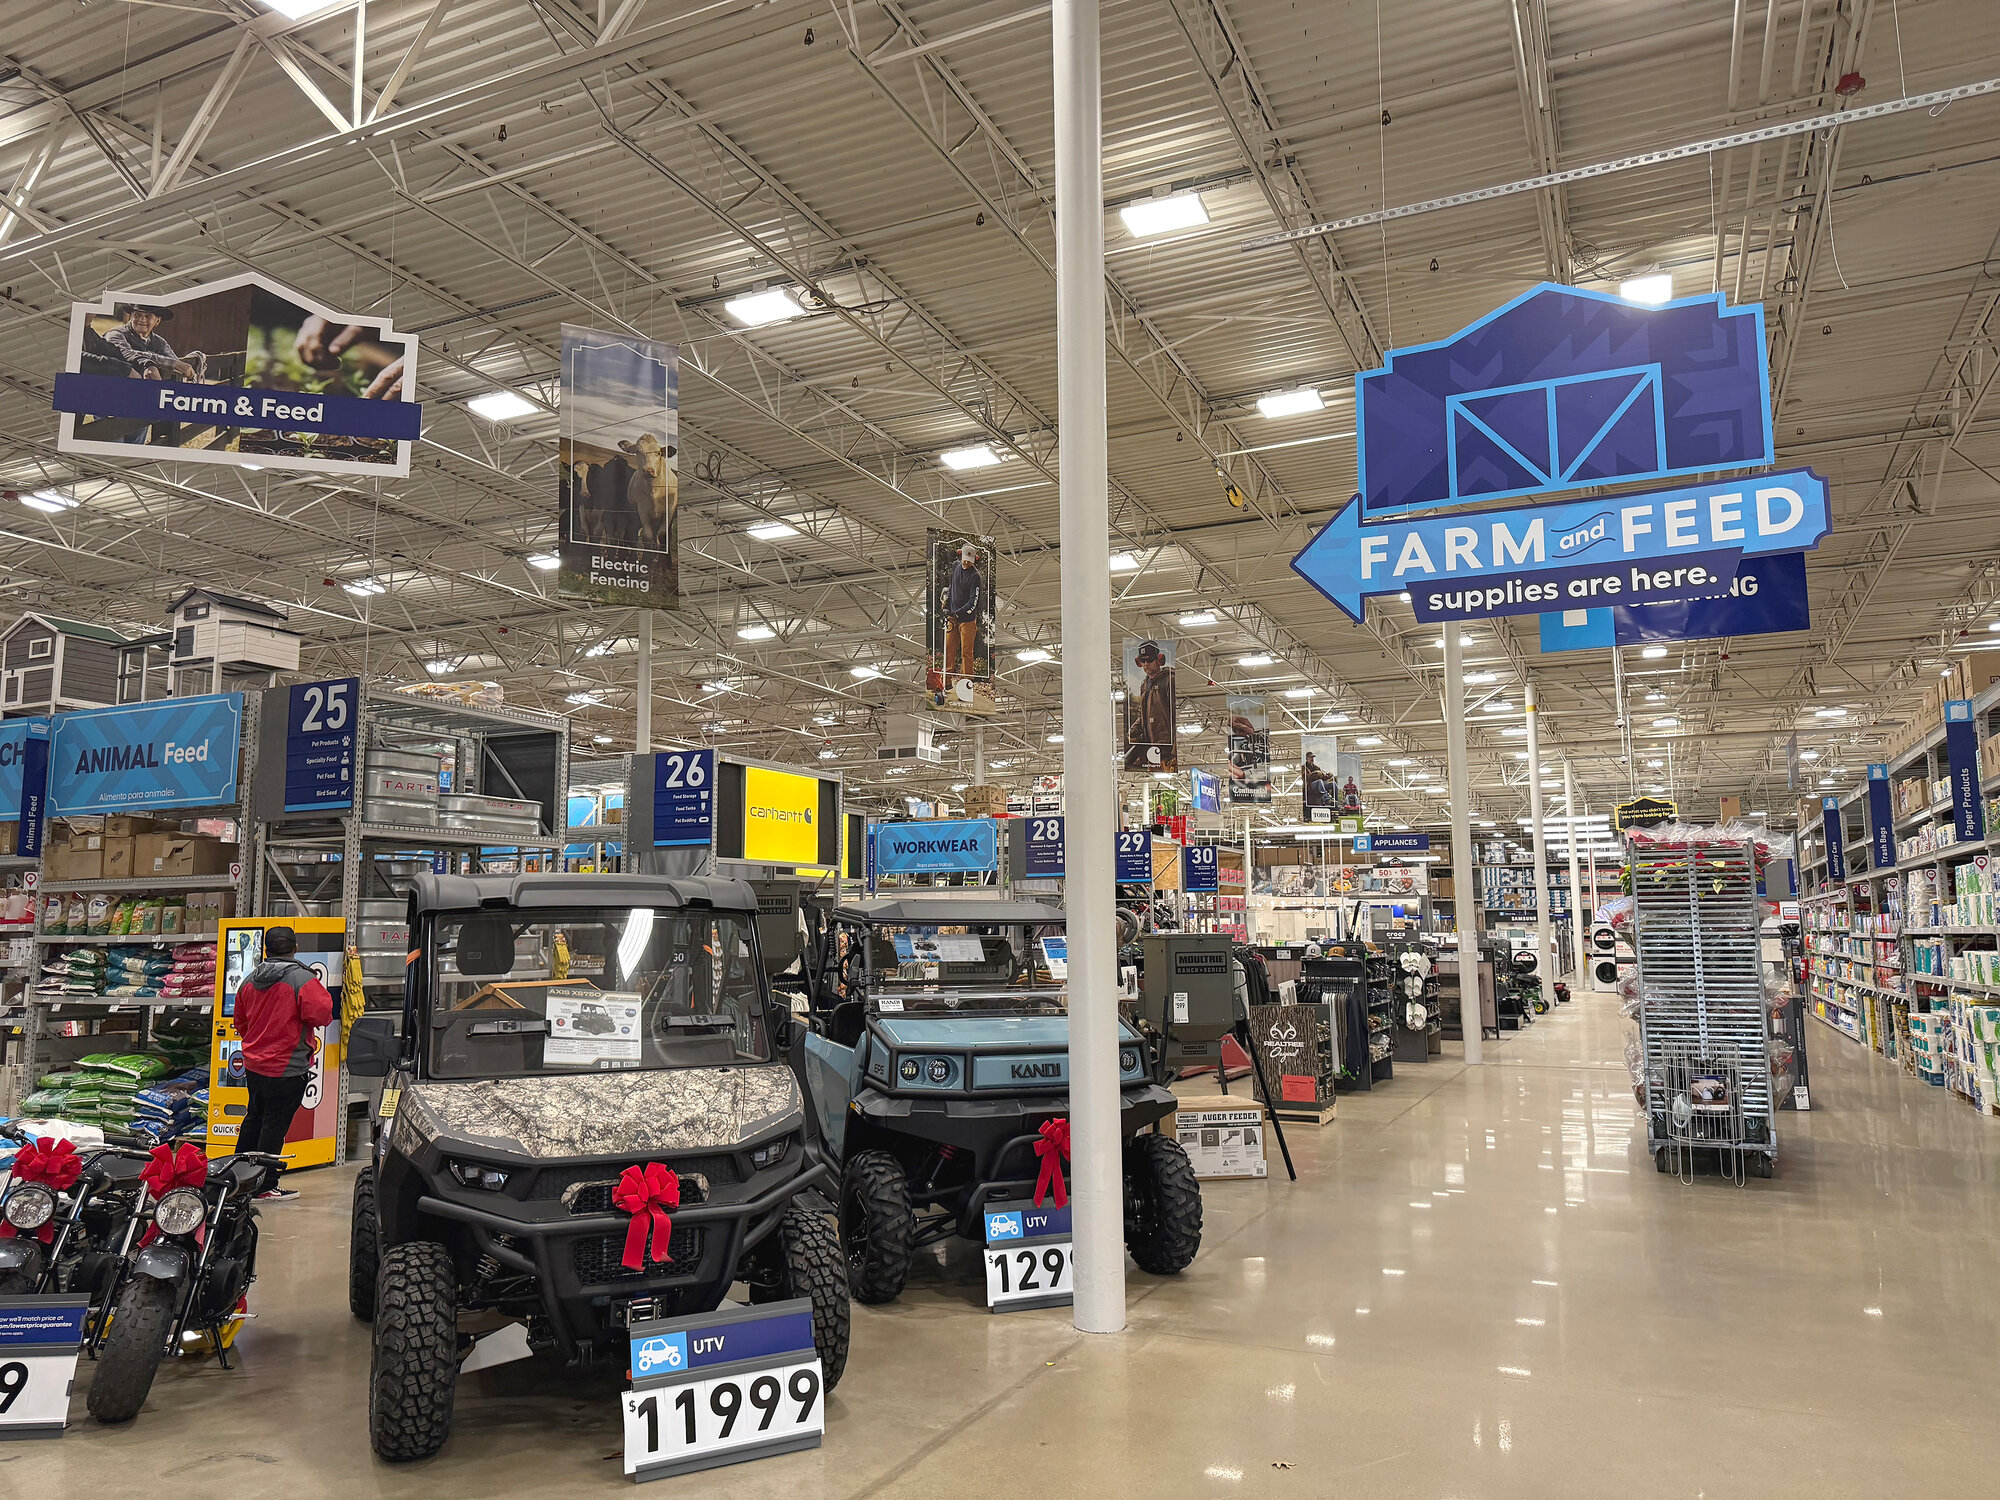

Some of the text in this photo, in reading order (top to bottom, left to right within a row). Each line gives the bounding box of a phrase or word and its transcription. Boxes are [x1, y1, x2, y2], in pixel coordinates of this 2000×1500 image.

[159, 389, 324, 423] Farm & Feed
[1360, 486, 1805, 580] FARM and FEED
[591, 555, 649, 574] Electric
[590, 572, 650, 592] Fencing
[1428, 577, 1559, 613] supplies
[1567, 576, 1622, 597] are
[1631, 566, 1718, 592] here.
[301, 684, 348, 732] 25
[75, 739, 208, 775] ANIMAL Feed
[666, 754, 705, 788] 26
[99, 788, 175, 802] Alimento para animales
[1232, 786, 1267, 794] Continental
[1962, 768, 1975, 836] Paper Products
[26, 796, 38, 851] Animal Feed
[750, 805, 802, 823] carhartt
[1032, 819, 1060, 841] 28
[893, 839, 979, 855] WORKWEAR
[1120, 833, 1144, 852] 29
[1191, 848, 1213, 865] 30
[1881, 845, 1889, 864] Trash
[1179, 956, 1225, 964] MOULTRIE
[1264, 1040, 1304, 1048] REALTREE
[1269, 1046, 1300, 1063] Original
[1011, 1063, 1062, 1079] KANDI
[1202, 1112, 1258, 1122] AUGER FEEDER
[213, 1126, 234, 1134] QUICK
[1026, 1216, 1048, 1228] UTV
[988, 1248, 1073, 1293] $129
[693, 1335, 725, 1355] UTV
[0, 1361, 29, 1414] 9
[628, 1368, 820, 1453] $11999
